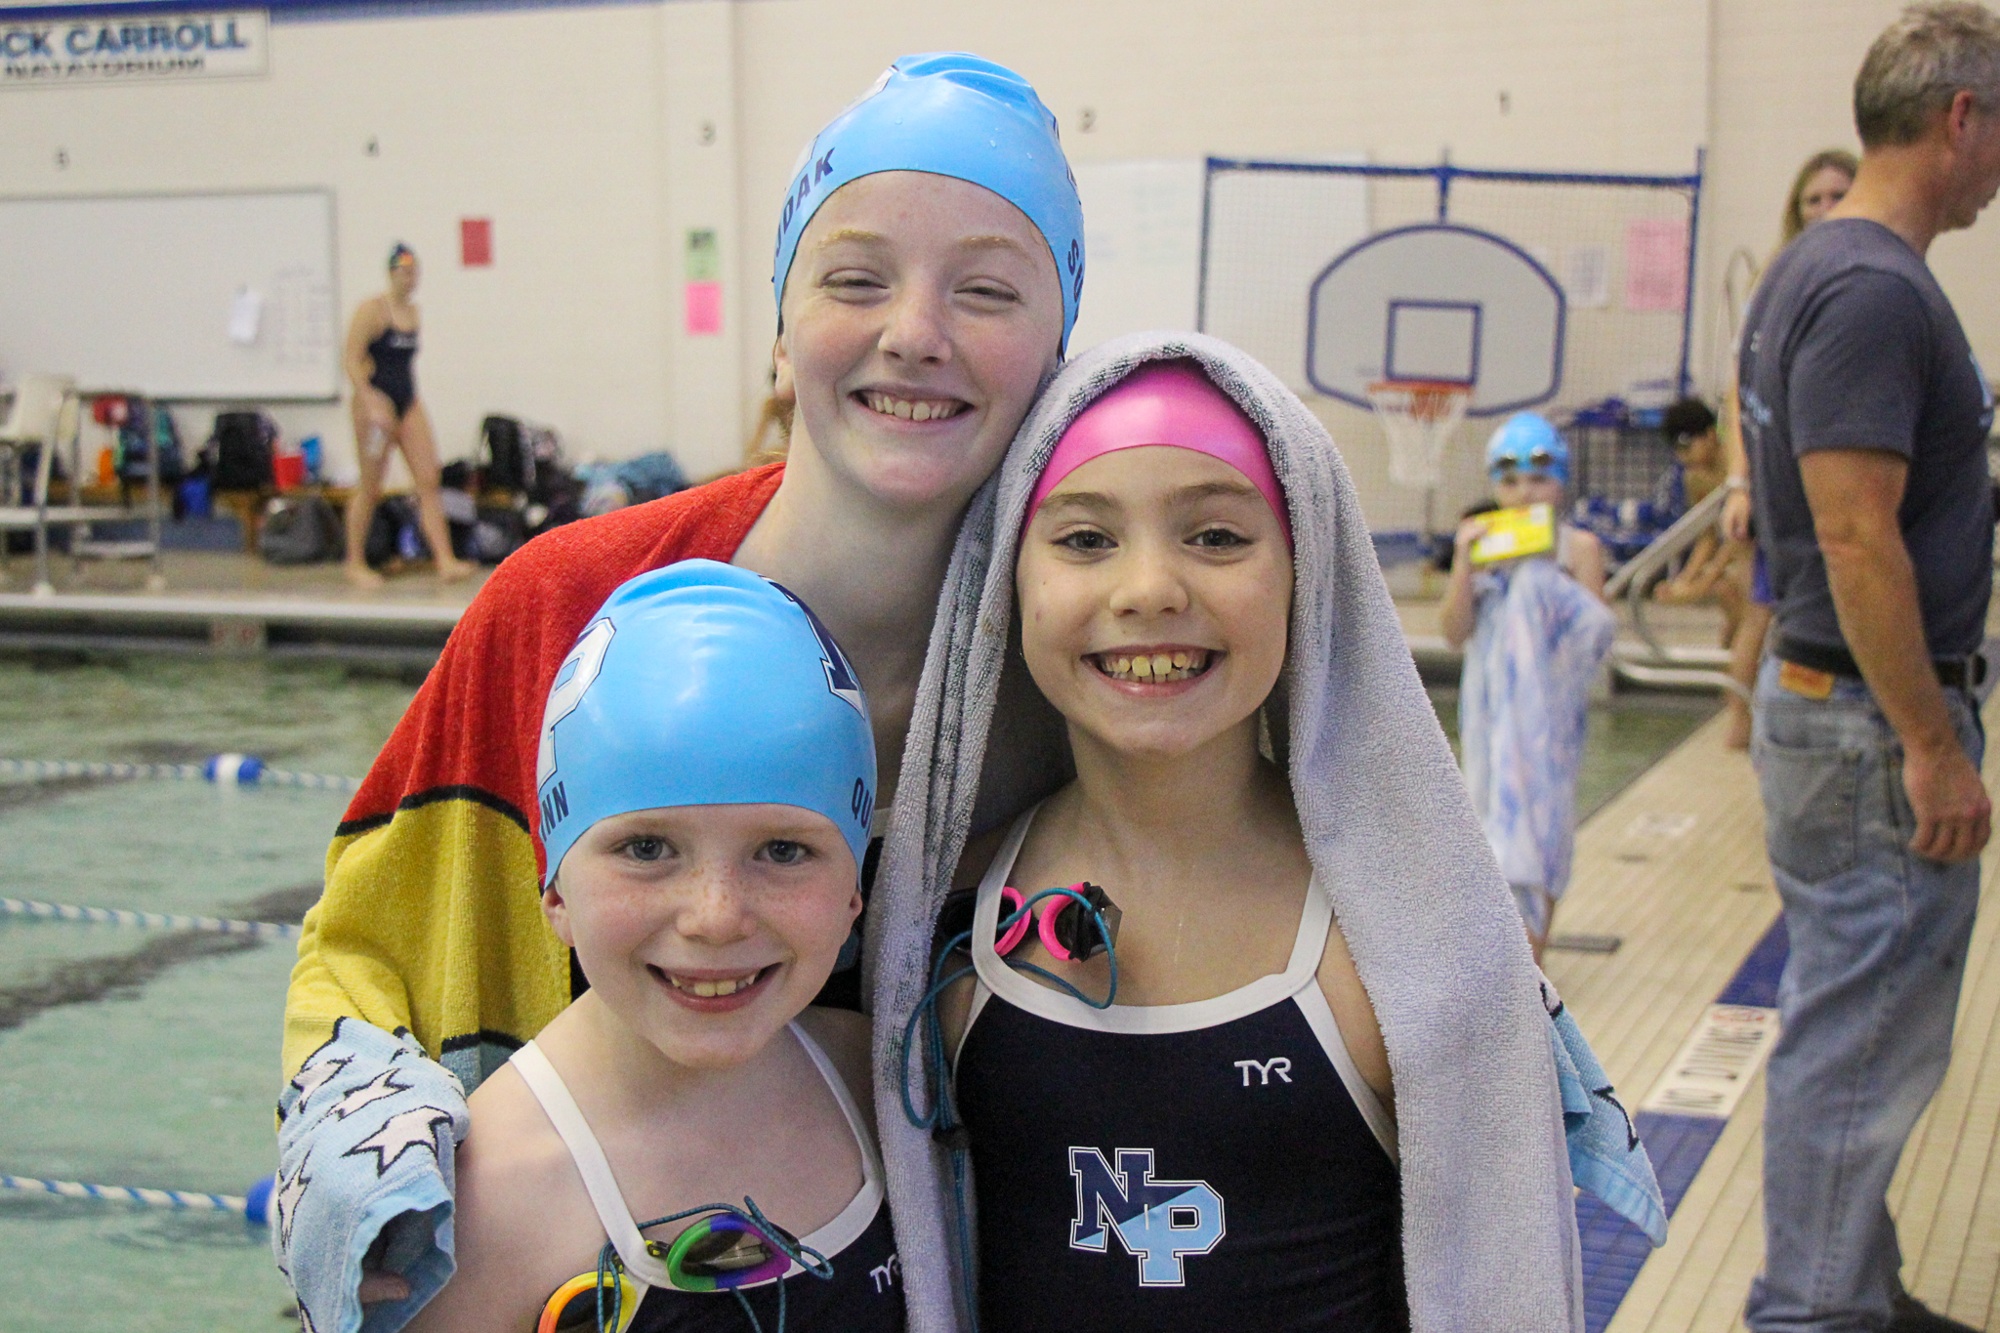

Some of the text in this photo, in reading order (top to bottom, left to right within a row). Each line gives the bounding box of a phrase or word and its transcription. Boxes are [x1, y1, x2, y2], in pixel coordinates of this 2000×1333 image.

[0, 22, 246, 58] CK CARROLL
[1234, 1057, 1293, 1086] TYR
[1069, 1146, 1226, 1287] NP
